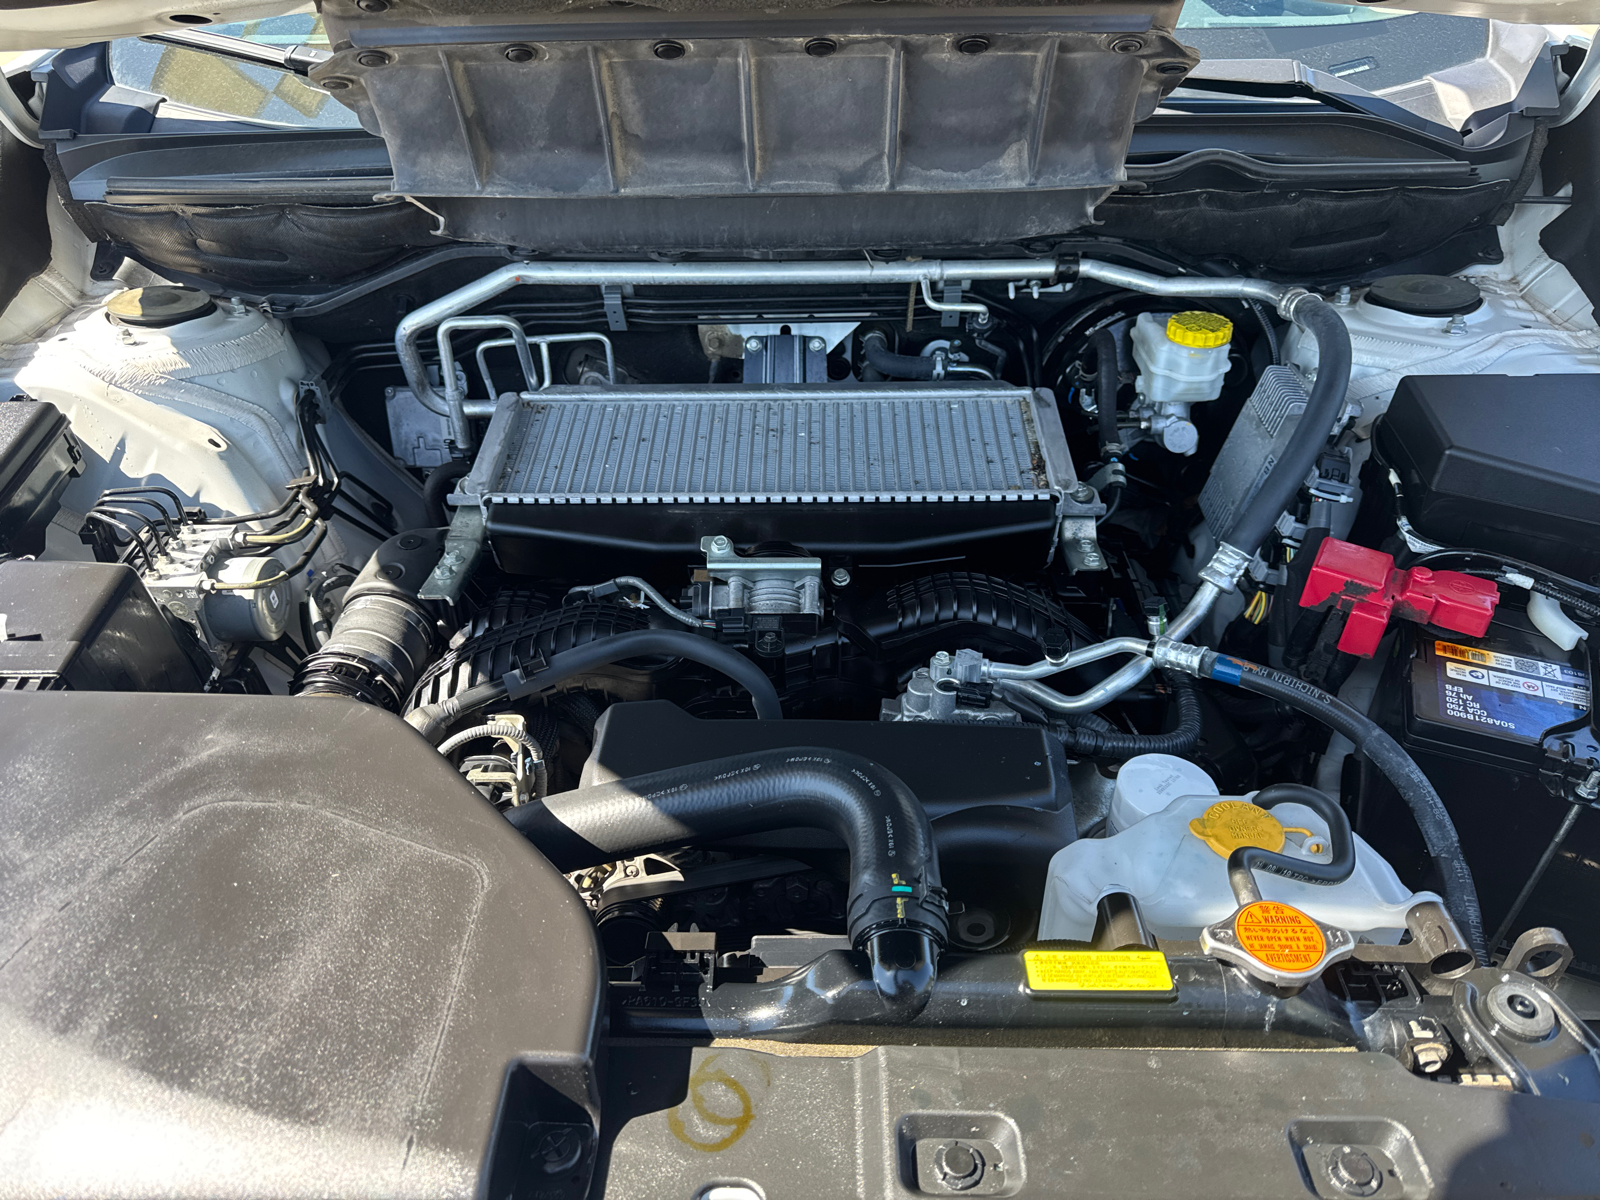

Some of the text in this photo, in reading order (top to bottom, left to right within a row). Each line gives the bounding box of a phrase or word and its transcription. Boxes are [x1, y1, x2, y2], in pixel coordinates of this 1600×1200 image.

[1445, 684, 1463, 693] EFB
[1445, 690, 1458, 698] 76
[1446, 696, 1480, 709] RC 120
[1446, 703, 1487, 717] CCA 750
[1208, 801, 1272, 820] COOLANT
[1259, 905, 1285, 914] 警告
[1262, 915, 1301, 924] WARNING
